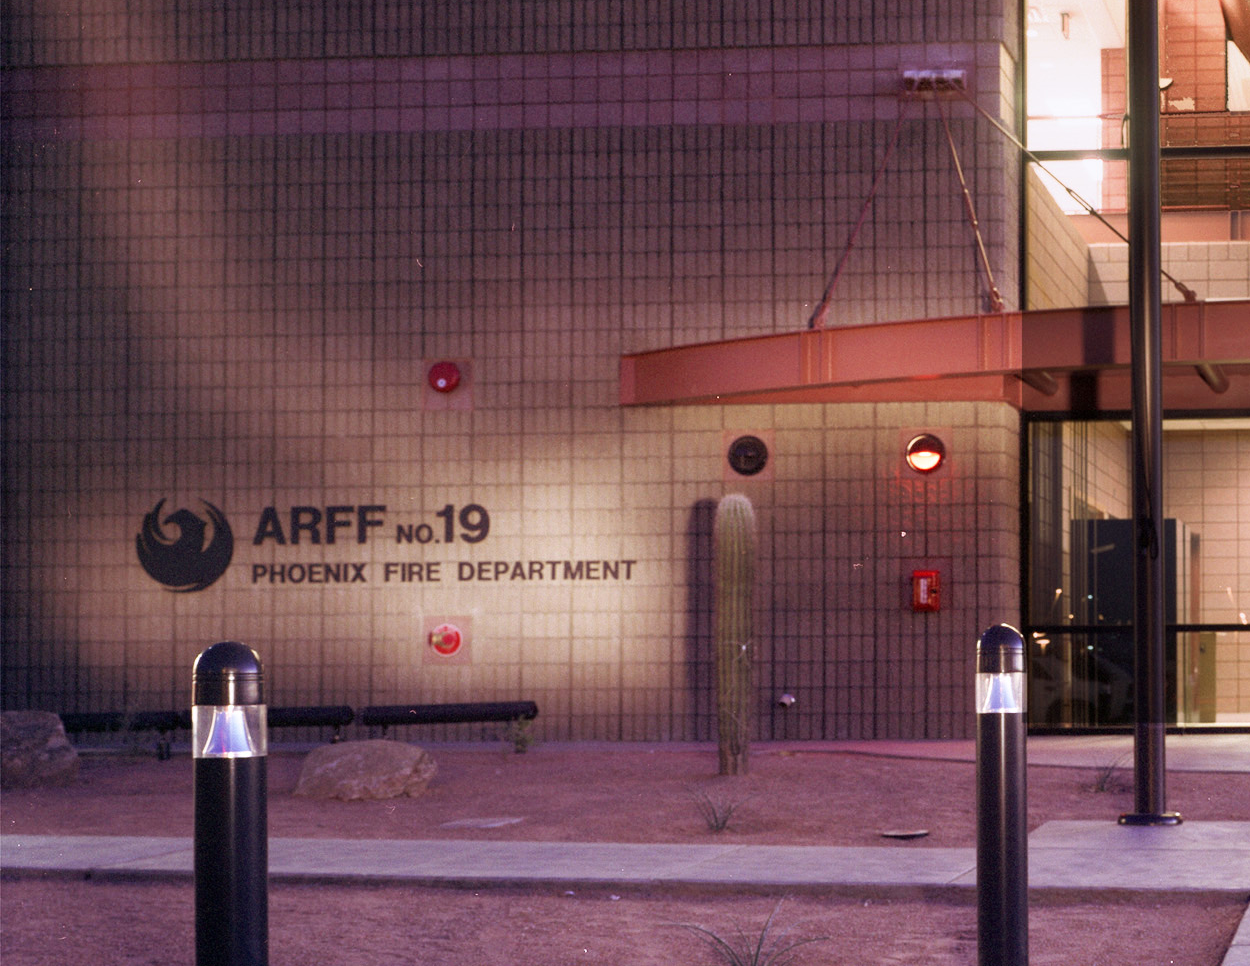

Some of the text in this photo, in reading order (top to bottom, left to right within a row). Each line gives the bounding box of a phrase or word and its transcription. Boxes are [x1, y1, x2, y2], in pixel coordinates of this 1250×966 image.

[252, 506, 386, 545] ARFF
[252, 560, 637, 584] PHOENIX FIRE DEPARTMENT
